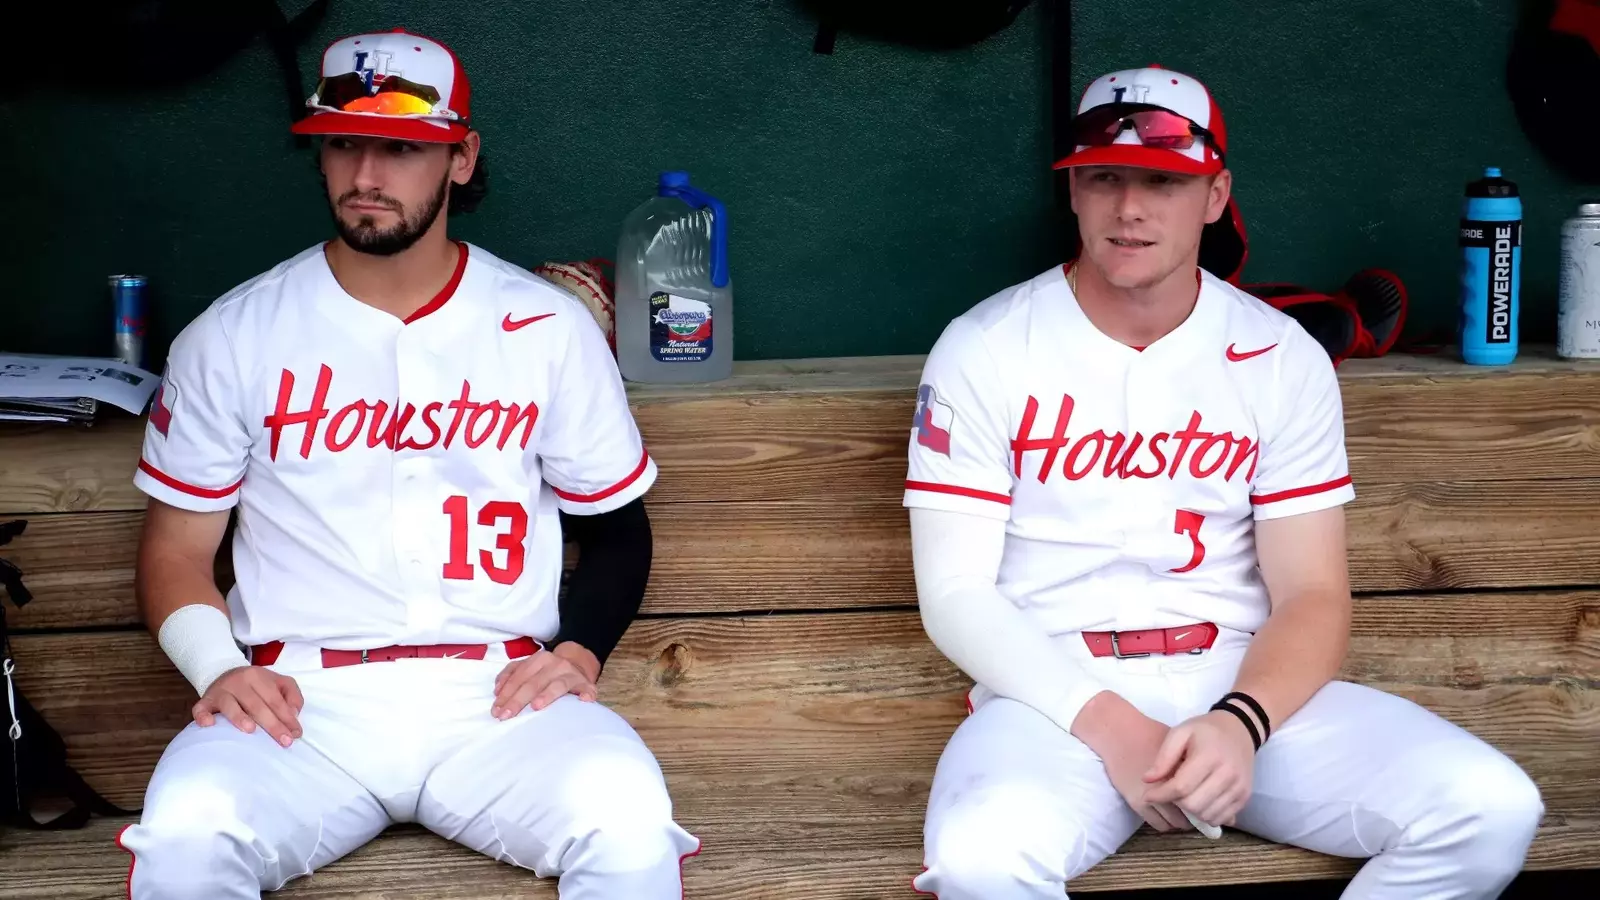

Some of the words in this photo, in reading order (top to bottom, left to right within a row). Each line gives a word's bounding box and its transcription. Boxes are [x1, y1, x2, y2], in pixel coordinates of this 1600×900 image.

[667, 340, 699, 348] Natural
[264, 363, 539, 463] Houston
[1010, 393, 1259, 485] Houston
[442, 495, 528, 585] 13
